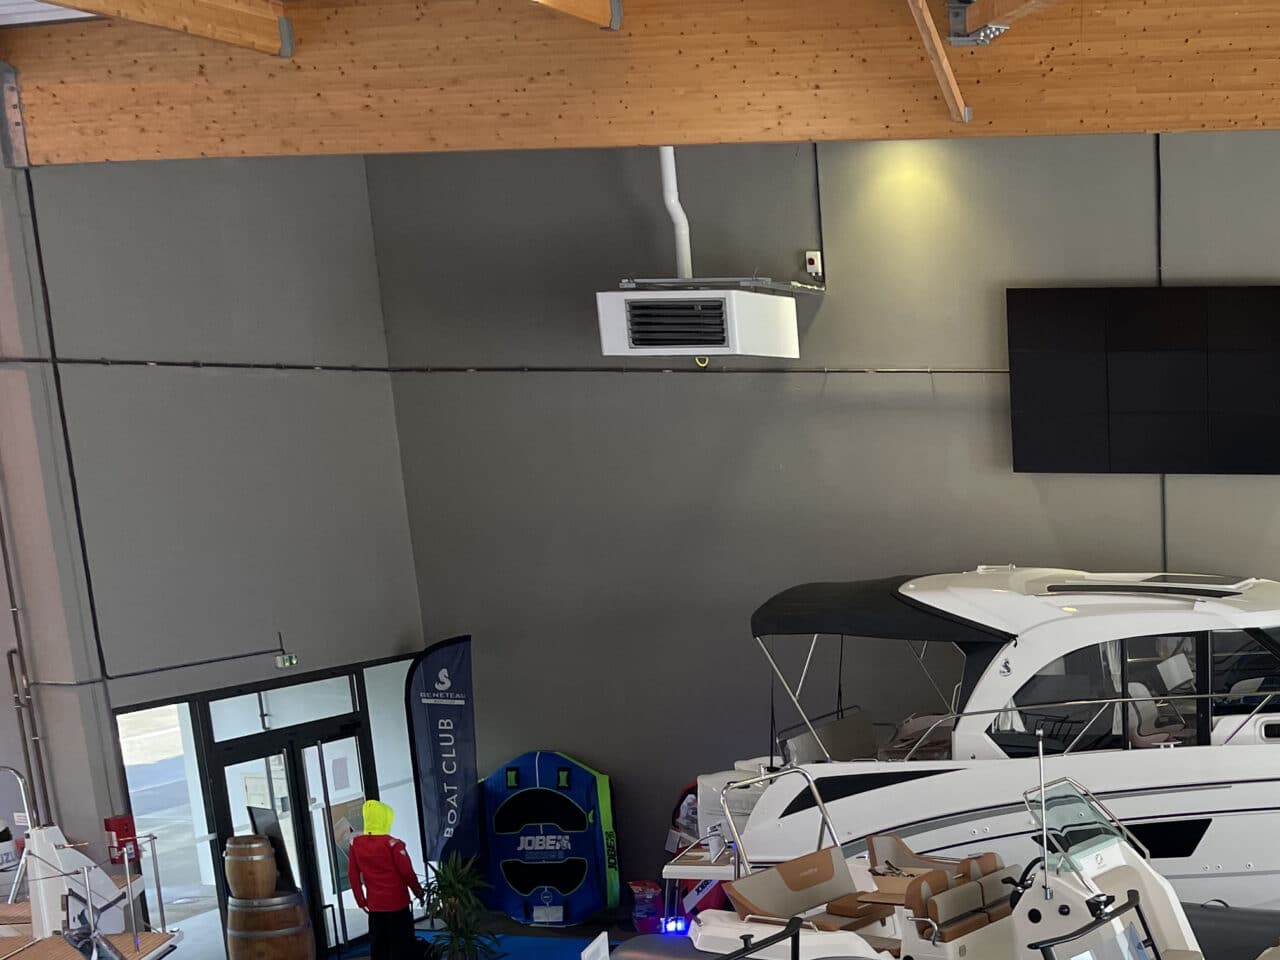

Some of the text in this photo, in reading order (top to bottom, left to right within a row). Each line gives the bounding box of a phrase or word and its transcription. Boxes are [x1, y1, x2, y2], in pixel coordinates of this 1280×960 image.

[420, 691, 466, 699] BENETEAU
[438, 718, 458, 775] CLUB
[443, 783, 458, 838] BOAT
[517, 835, 558, 851] JOBE
